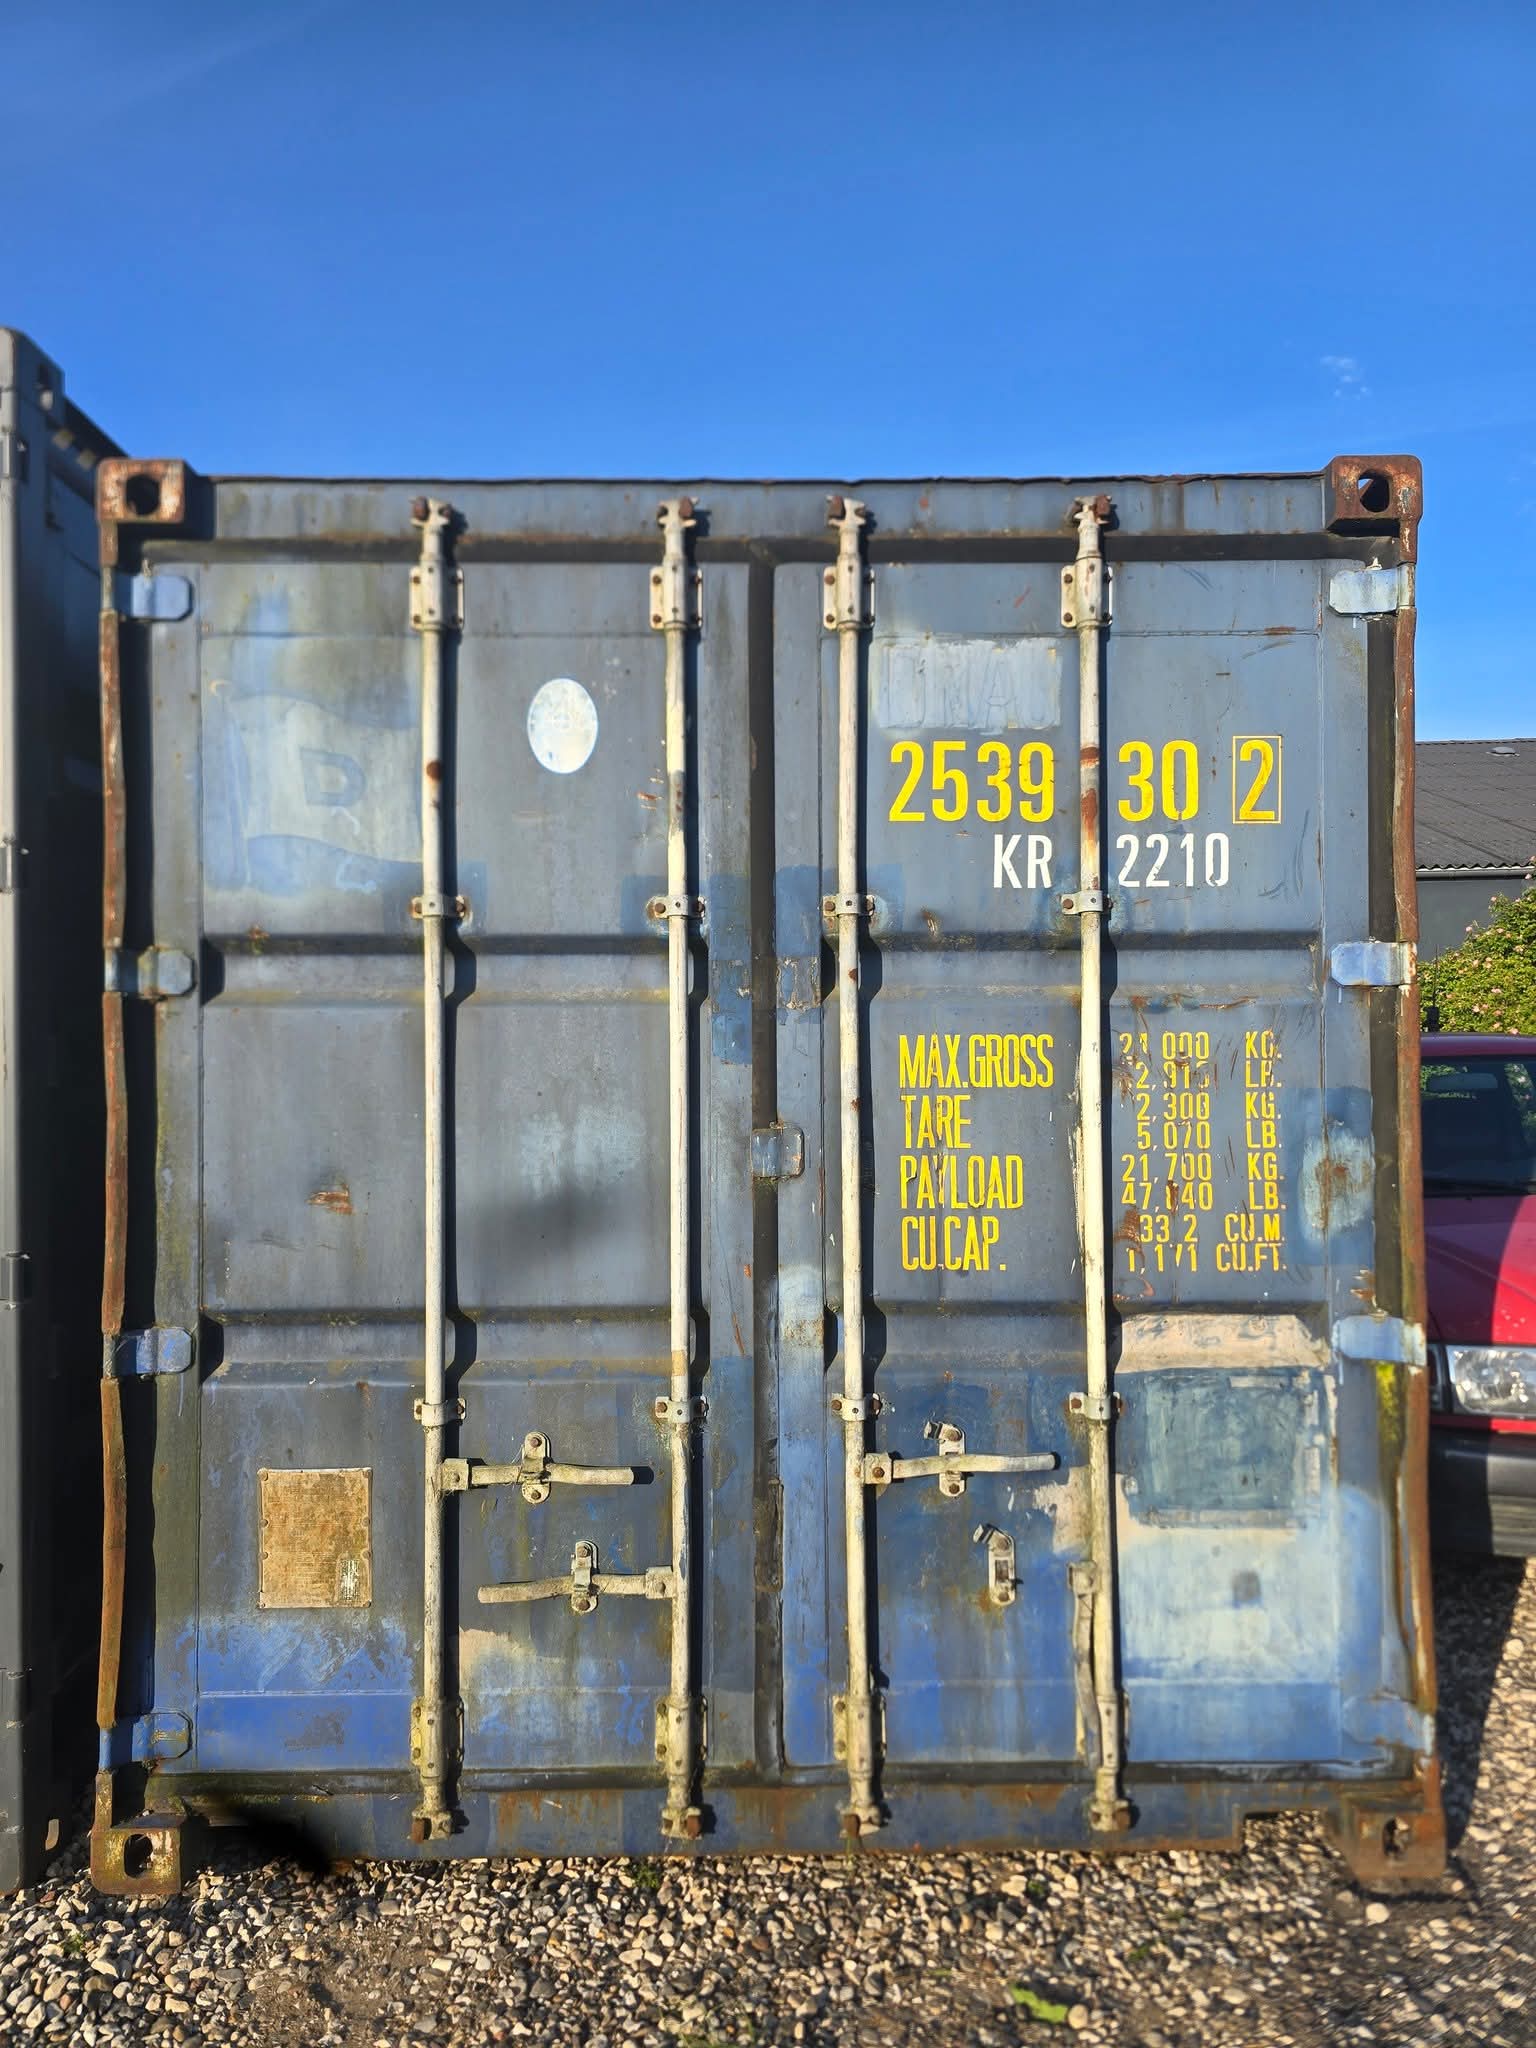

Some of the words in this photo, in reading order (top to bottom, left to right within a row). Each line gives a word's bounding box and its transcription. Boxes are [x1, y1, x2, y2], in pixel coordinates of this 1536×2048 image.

[889, 739, 1055, 823] 2539
[1118, 740, 1199, 821] 30
[1239, 739, 1276, 820] 2
[993, 834, 1054, 889] KR
[1116, 832, 1230, 888] 2210
[901, 1094, 972, 1149] TARE
[1136, 1092, 1210, 1122] 2,300
[1245, 1091, 1282, 1119] KG.
[1137, 1120, 1211, 1151] 5,070
[1246, 1120, 1282, 1149] LB.
[901, 1154, 1024, 1210] PAYLOAD
[1121, 1152, 1212, 1184] 21,700
[1247, 1151, 1285, 1181] KG.
[1249, 1182, 1287, 1210] LB.
